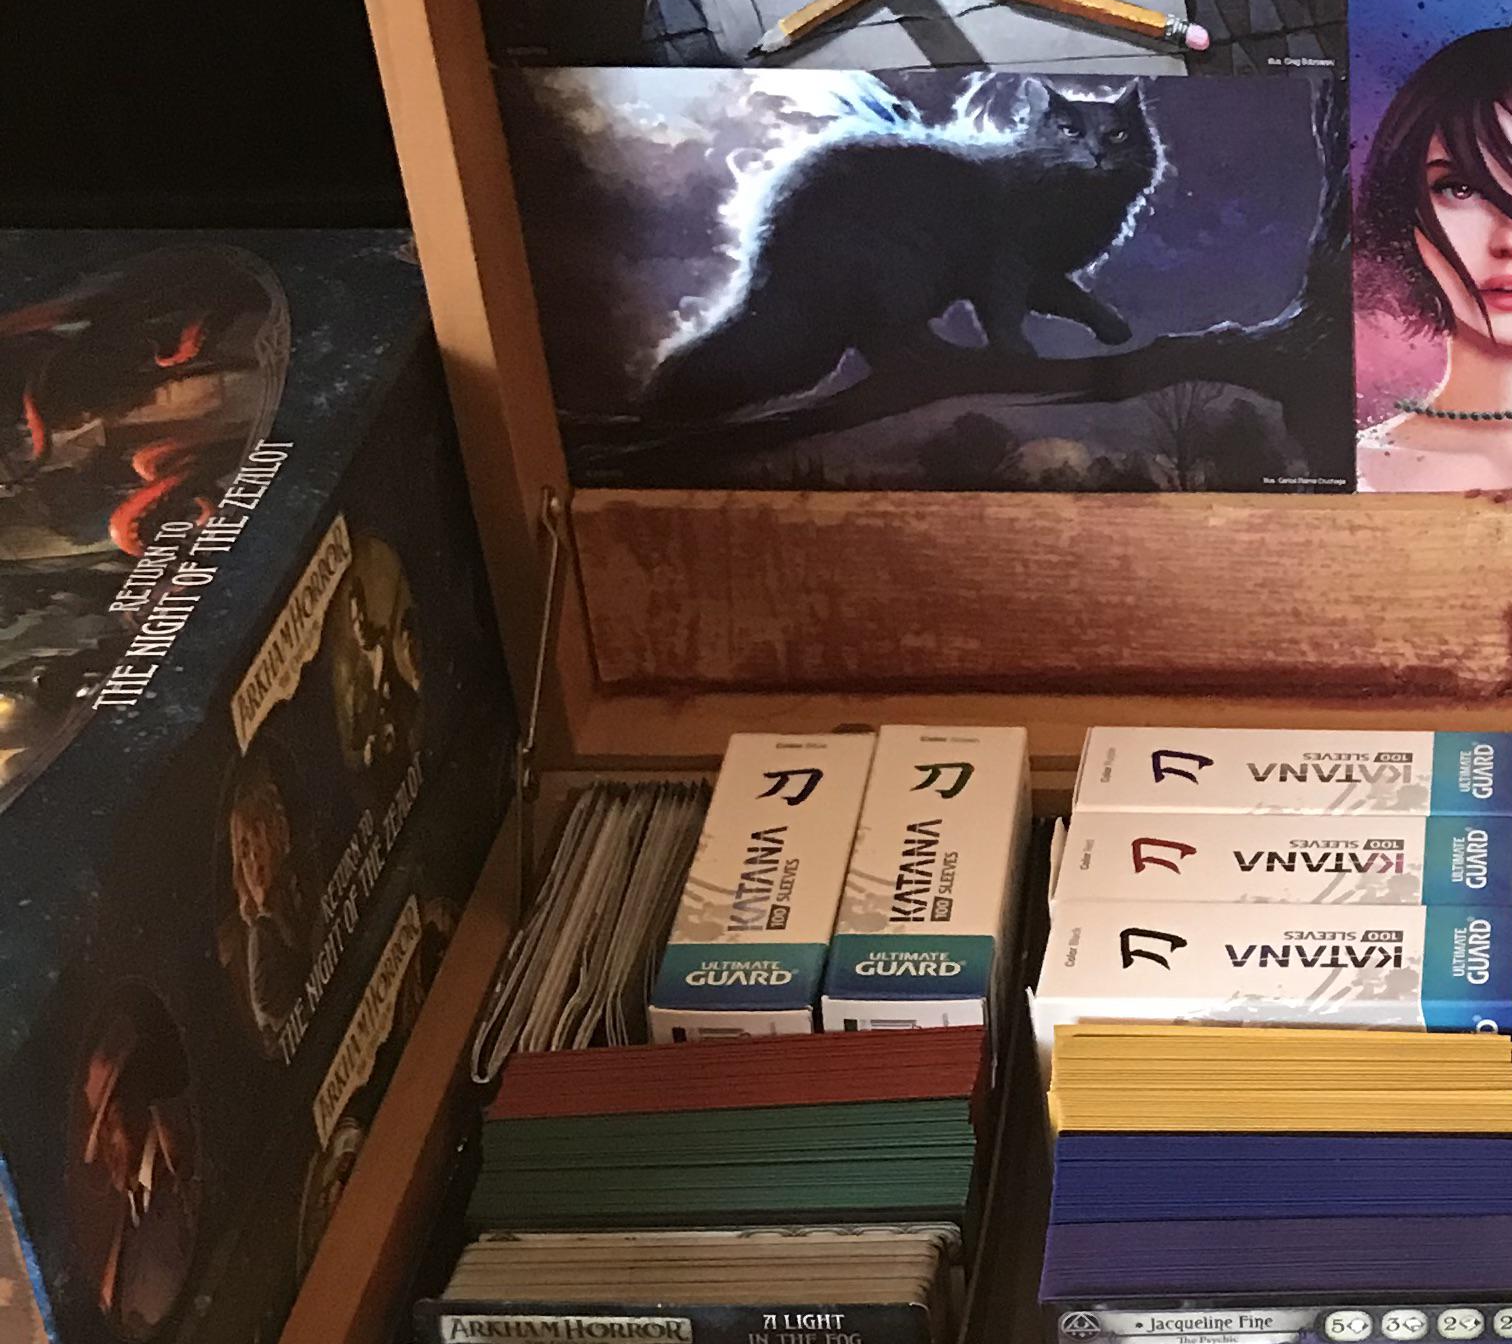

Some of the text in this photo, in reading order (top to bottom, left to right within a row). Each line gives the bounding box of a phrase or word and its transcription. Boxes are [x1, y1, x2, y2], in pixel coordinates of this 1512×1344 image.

[92, 438, 295, 711] THE NIGHT OF THE ZEALOT
[109, 521, 194, 612] RETURN TO
[1246, 763, 1412, 784] KATANA
[1303, 752, 1411, 762] 100 SLEEVES
[1459, 750, 1472, 793] ULTIMATE
[1472, 743, 1495, 799] GUARD
[1289, 839, 1402, 850] 100 SLEEVES
[1452, 836, 1465, 883] ULTIMATE
[1466, 829, 1488, 889] GUARD
[320, 834, 363, 920] RETURN
[727, 825, 790, 931] KATANA
[888, 818, 943, 923] KATANA
[1233, 851, 1405, 874] KATANA
[769, 858, 800, 928] 100 SLEEVES
[932, 852, 959, 921] 100 SLEEVES
[1283, 930, 1400, 941] 100 SLEEVES
[1452, 927, 1467, 977] ULTIMATE
[1466, 918, 1492, 985] GUARD
[305, 922, 344, 1011] NIGHT
[701, 961, 780, 970] ULTIMATE
[855, 961, 962, 977] GUARD
[869, 952, 950, 961] ULTIMATE
[1225, 944, 1402, 968] KATANA
[685, 970, 793, 987] GUARD
[451, 1318, 690, 1342] ARKHAM HORROR
[763, 1314, 845, 1330] A LIGHT
[1147, 1315, 1273, 1333] Jacqueline Fine
[1331, 1316, 1512, 1333] 5 3 2 2
